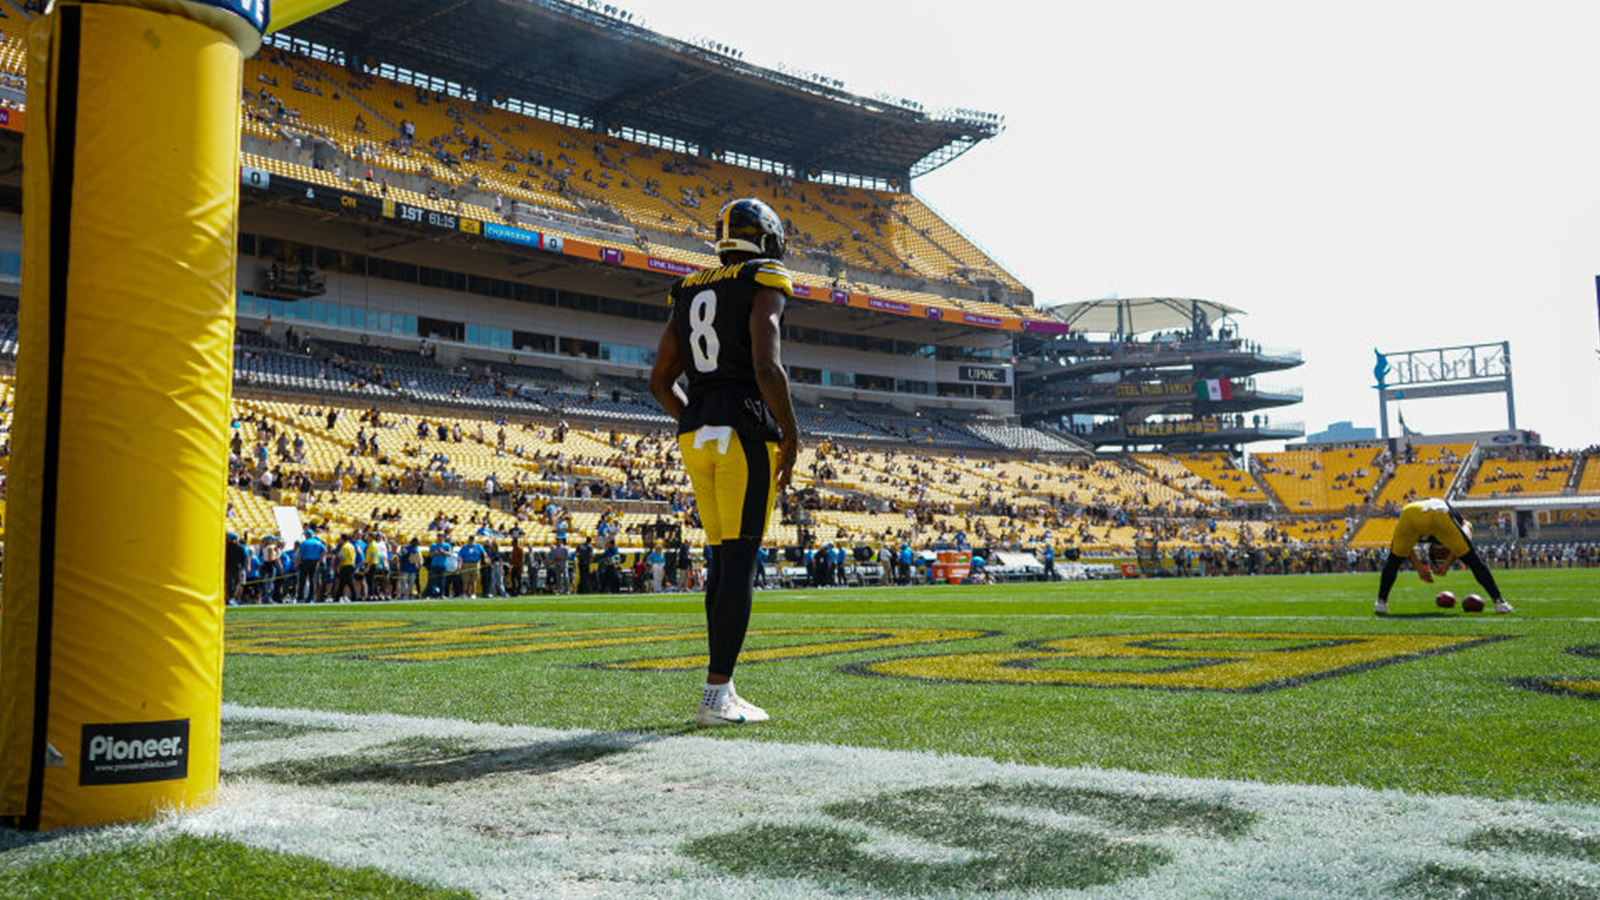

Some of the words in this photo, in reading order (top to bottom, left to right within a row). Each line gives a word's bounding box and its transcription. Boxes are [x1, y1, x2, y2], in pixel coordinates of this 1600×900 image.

[400, 205, 424, 222] 1ST
[689, 289, 720, 373] 8
[967, 367, 999, 381] UPMC
